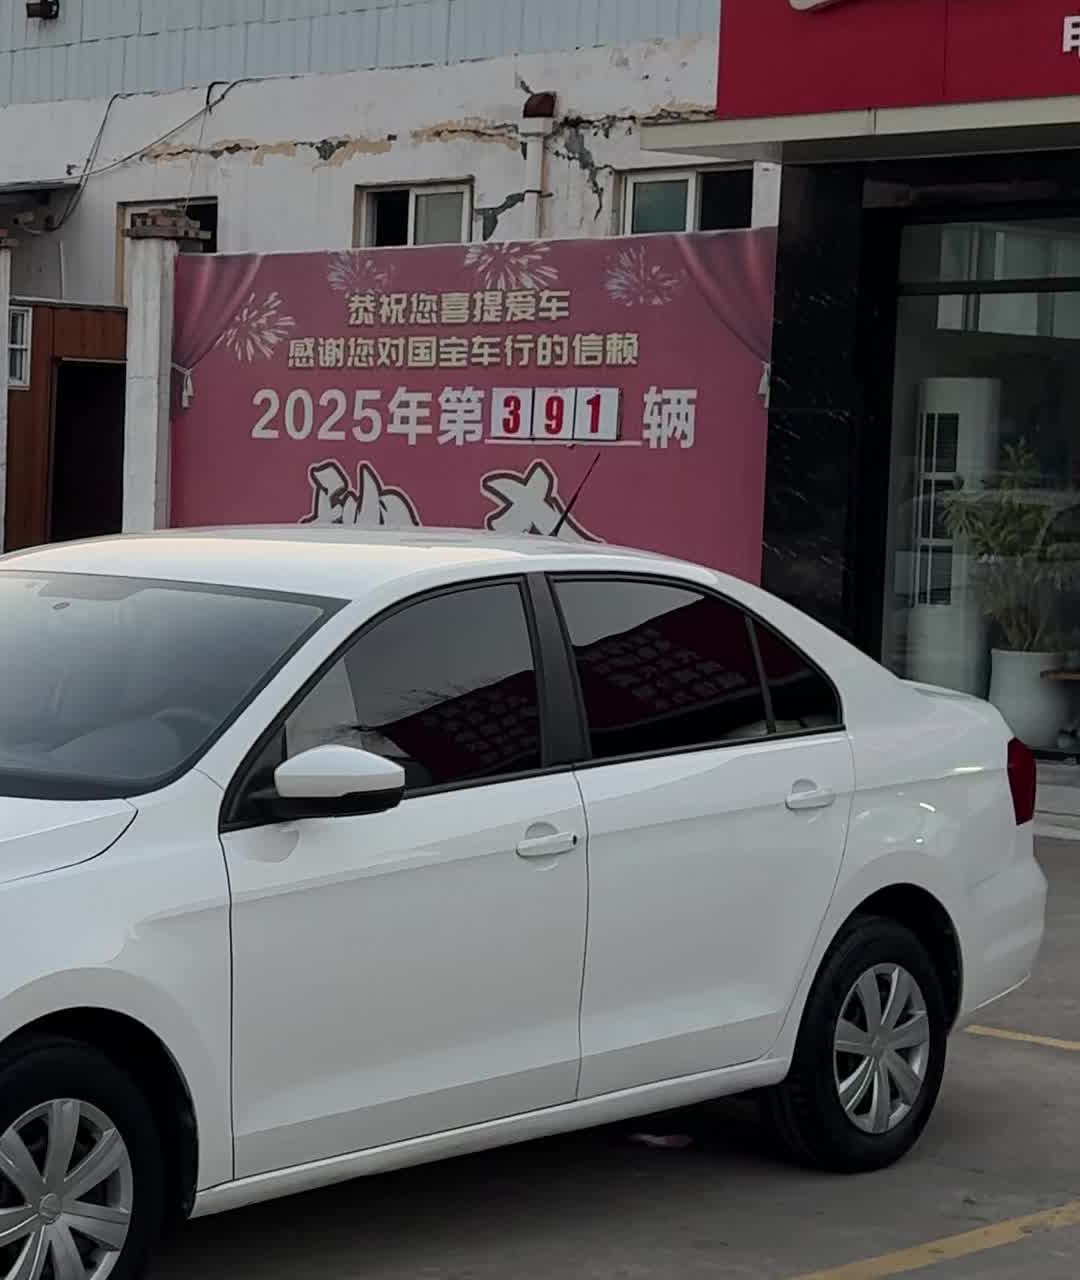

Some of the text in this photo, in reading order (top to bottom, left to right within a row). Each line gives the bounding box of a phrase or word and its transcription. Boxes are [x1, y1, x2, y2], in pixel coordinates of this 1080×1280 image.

[347, 290, 571, 326] 恭祝您喜提爱车
[287, 332, 640, 370] 感谢您对国宝车行的信赖
